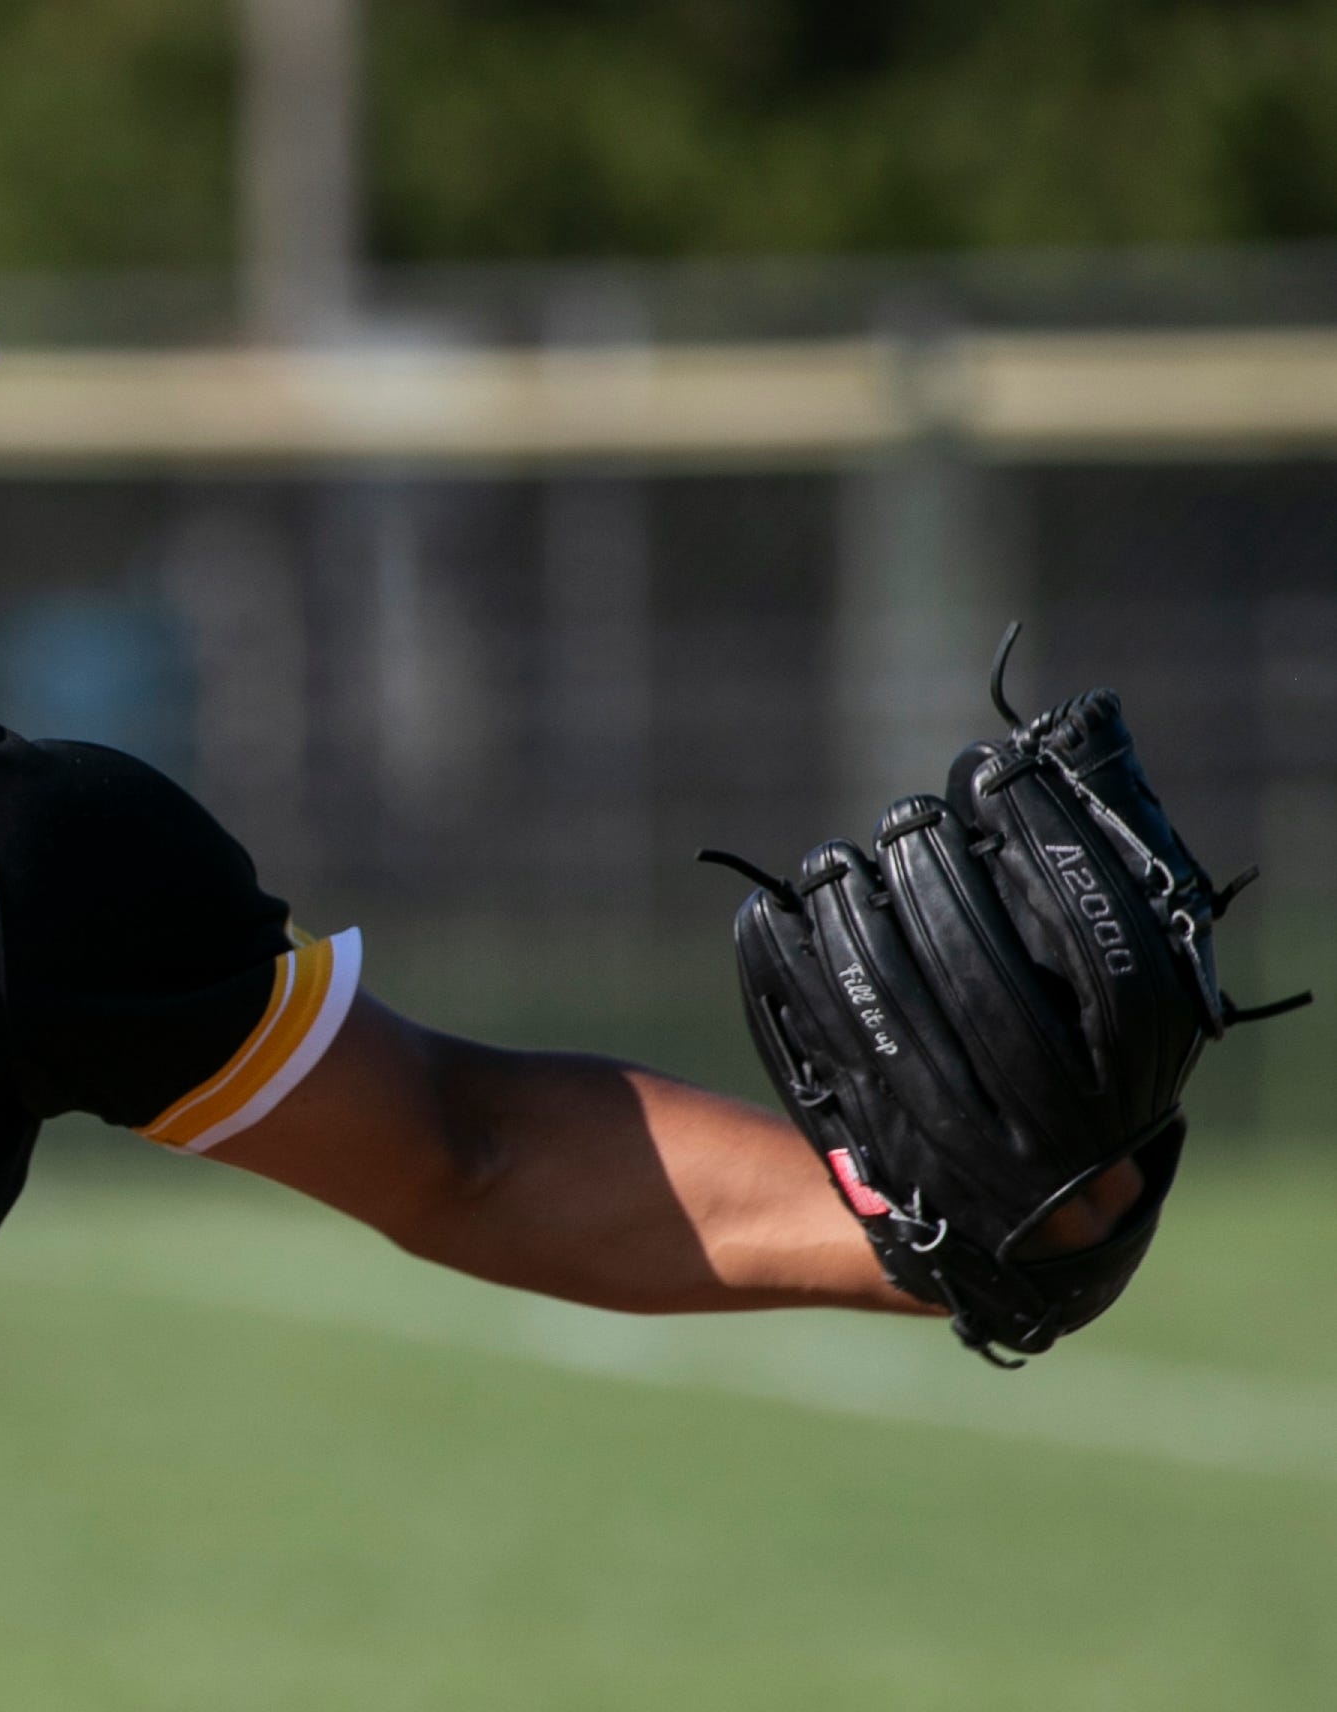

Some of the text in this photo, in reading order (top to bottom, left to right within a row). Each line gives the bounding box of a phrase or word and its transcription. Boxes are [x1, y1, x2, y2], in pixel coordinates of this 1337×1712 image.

[1045, 845, 1134, 975] A2000
[838, 962, 898, 1055] Fill it up
